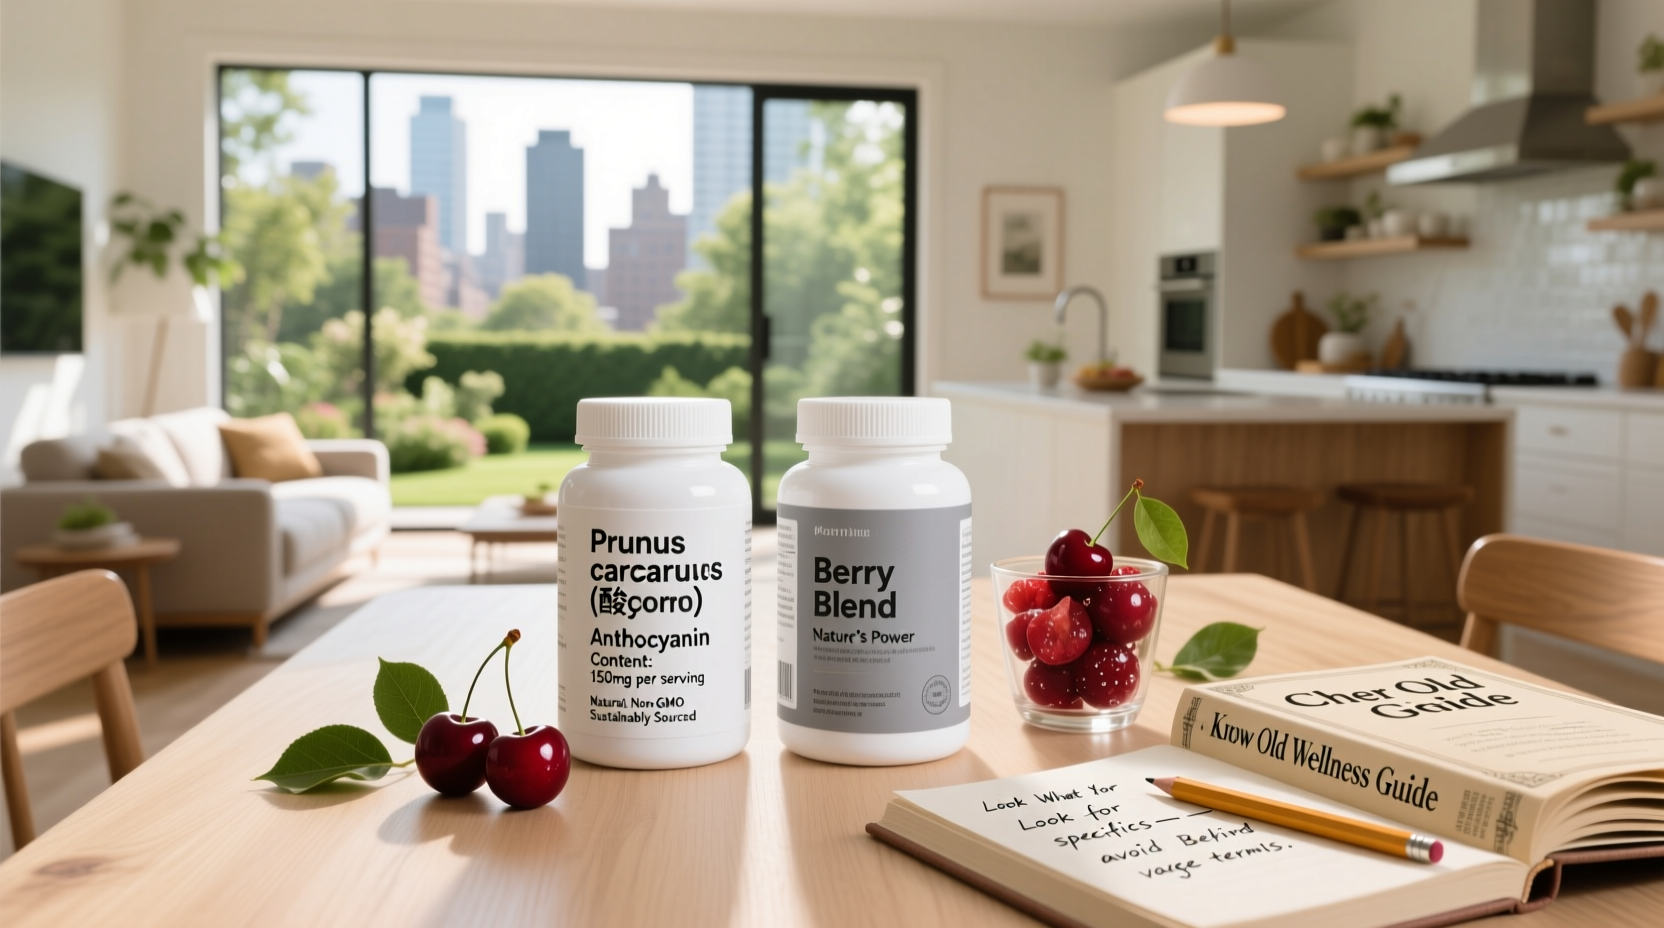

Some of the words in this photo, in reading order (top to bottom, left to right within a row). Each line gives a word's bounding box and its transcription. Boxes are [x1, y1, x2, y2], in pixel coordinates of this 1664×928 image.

[590, 528, 686, 554] Prunus
[814, 556, 895, 592] Berry
[814, 590, 896, 619] Blend
[590, 627, 710, 653] Anthocyanin
[871, 630, 915, 644] Power
[590, 652, 653, 668] Content:
[590, 670, 632, 688] 150mg
[636, 674, 656, 688] per
[661, 672, 705, 686] serving
[1284, 690, 1395, 707] Cher
[1395, 674, 1486, 695] Old
[1257, 727, 1289, 761] Old
[1293, 737, 1371, 788] Wellness
[1376, 766, 1439, 812] Guide
[983, 797, 1028, 812] Look
[1033, 789, 1083, 803] What
[1018, 812, 1074, 831] Look
[1084, 804, 1120, 821] for
[1101, 839, 1162, 864] avoid
